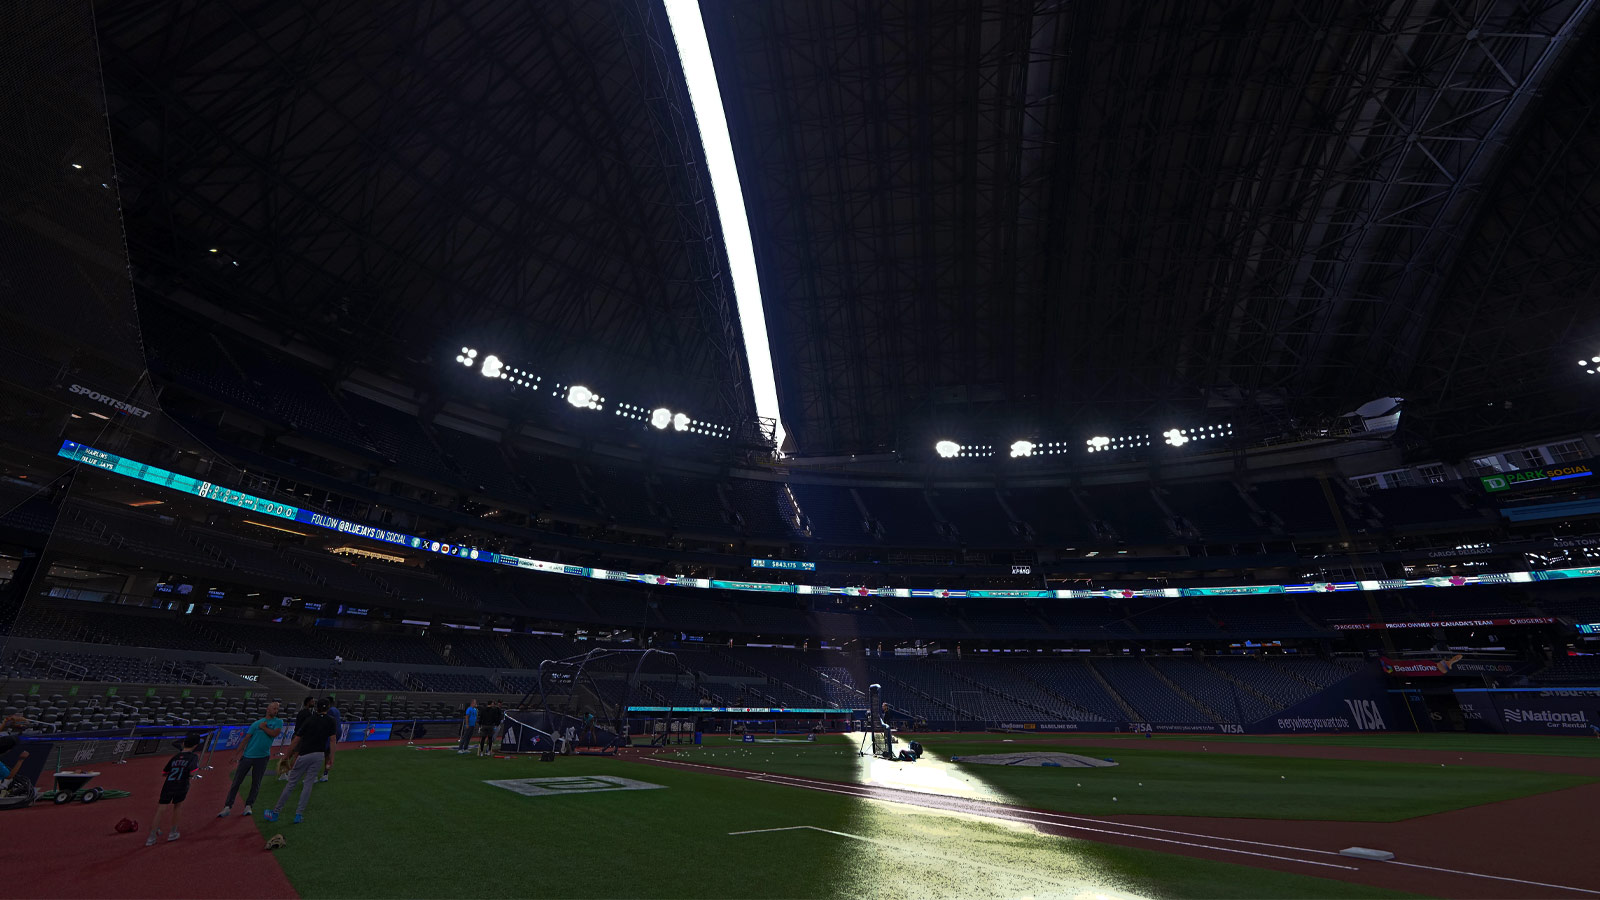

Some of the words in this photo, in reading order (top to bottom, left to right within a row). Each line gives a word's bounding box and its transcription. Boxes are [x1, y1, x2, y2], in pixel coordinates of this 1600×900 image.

[69, 384, 151, 418] SPORTSNET
[85, 448, 108, 460] MARLINS
[81, 455, 98, 465] BLUE
[99, 461, 114, 470] JAYS
[1484, 478, 1506, 489] TD
[1506, 468, 1546, 483] PARK
[1546, 465, 1591, 477] SOCIAL
[311, 513, 338, 529] FOLLOW
[338, 520, 376, 537] @BLUEJAYS
[376, 529, 386, 540] ON
[386, 531, 406, 545] SOCIAL
[1575, 538, 1597, 546] TOM
[1428, 550, 1457, 558] CARLOS
[1458, 548, 1493, 556] DELGADO
[1394, 664, 1438, 672] BeautiTone
[1456, 664, 1485, 672] RETHINK
[1486, 664, 1513, 672] COLOUR
[1343, 699, 1387, 730] VISA
[1220, 724, 1245, 734] VISA
[168, 767, 184, 781] 21
